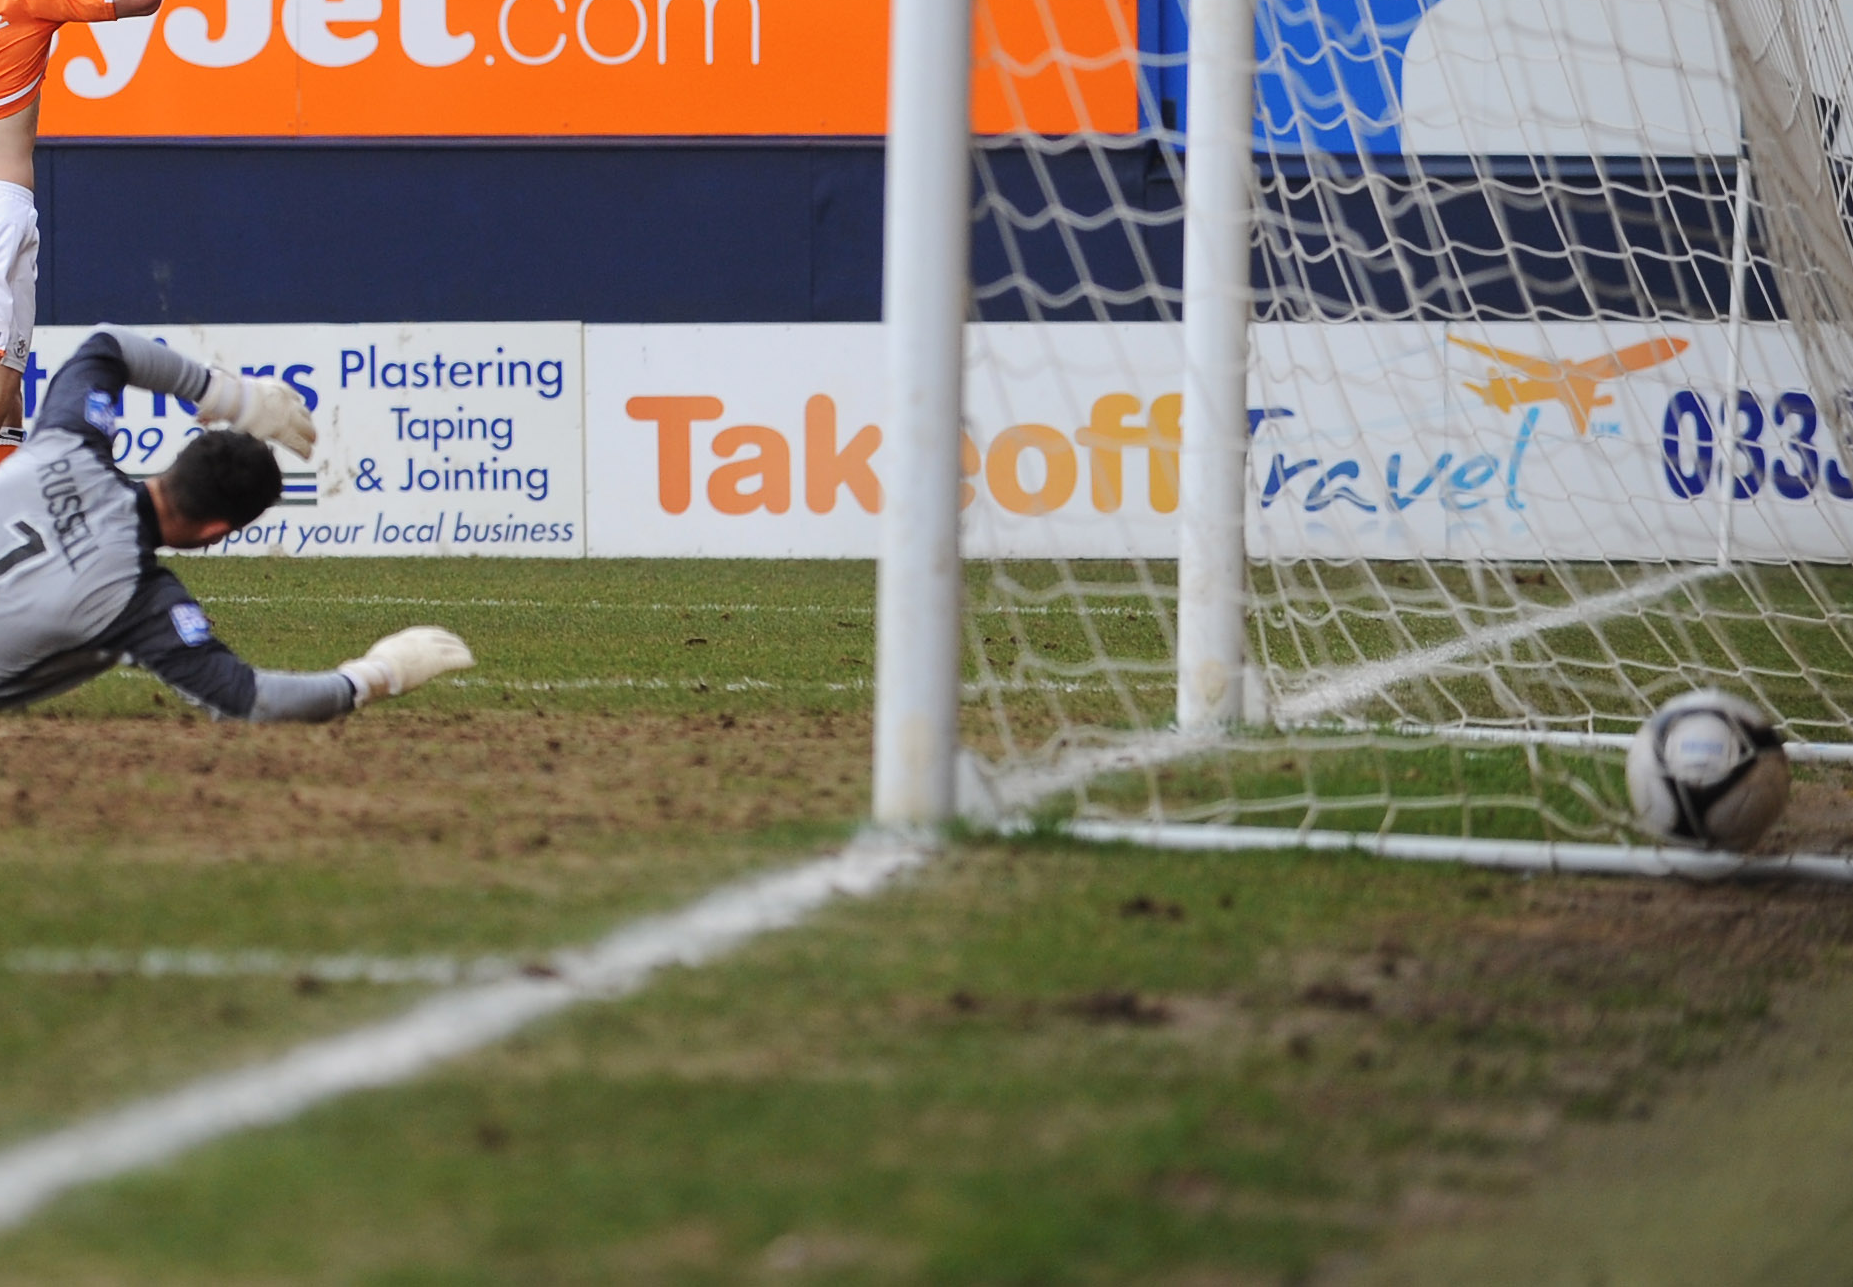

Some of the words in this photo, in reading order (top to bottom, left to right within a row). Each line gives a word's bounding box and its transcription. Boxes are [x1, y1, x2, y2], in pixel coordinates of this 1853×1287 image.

[340, 344, 564, 400] Plastering
[390, 405, 514, 452] Taping
[624, 392, 1183, 516] Takoff
[354, 456, 385, 493] &
[398, 455, 549, 502] Jointing
[36, 458, 99, 574] RUSSELL
[295, 524, 364, 553] your
[373, 511, 445, 545] local
[452, 511, 575, 545] business
